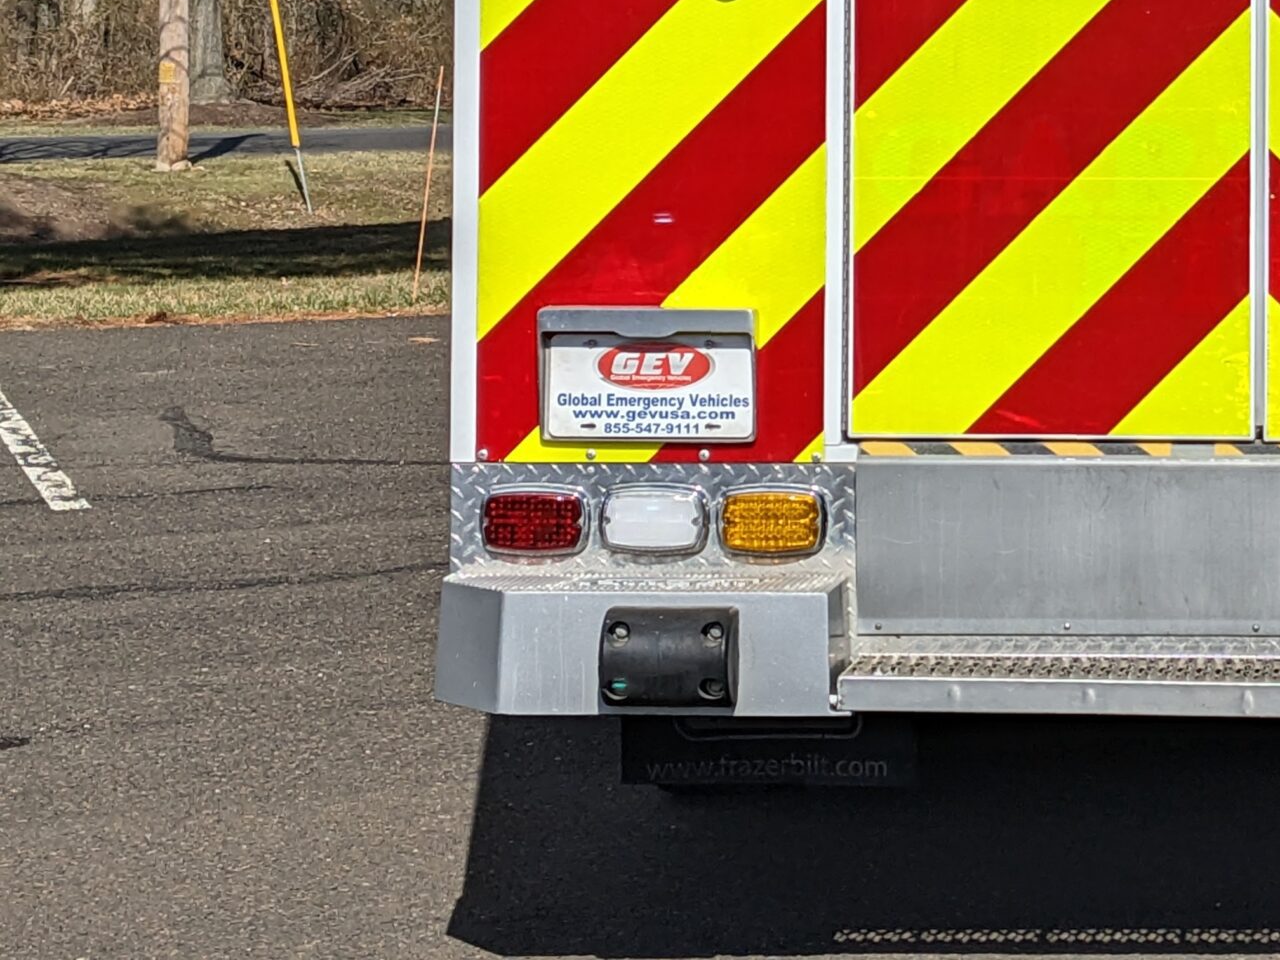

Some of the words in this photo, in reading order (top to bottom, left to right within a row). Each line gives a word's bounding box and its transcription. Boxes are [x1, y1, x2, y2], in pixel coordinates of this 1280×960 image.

[611, 352, 695, 375] GEV
[557, 393, 602, 407] Global
[606, 393, 685, 411] Emergency
[689, 393, 750, 408] Vehicles
[572, 409, 736, 422] www.gevusa.com
[603, 422, 700, 435] 855-547-9111
[646, 753, 889, 781] www.frazerbilt.com
